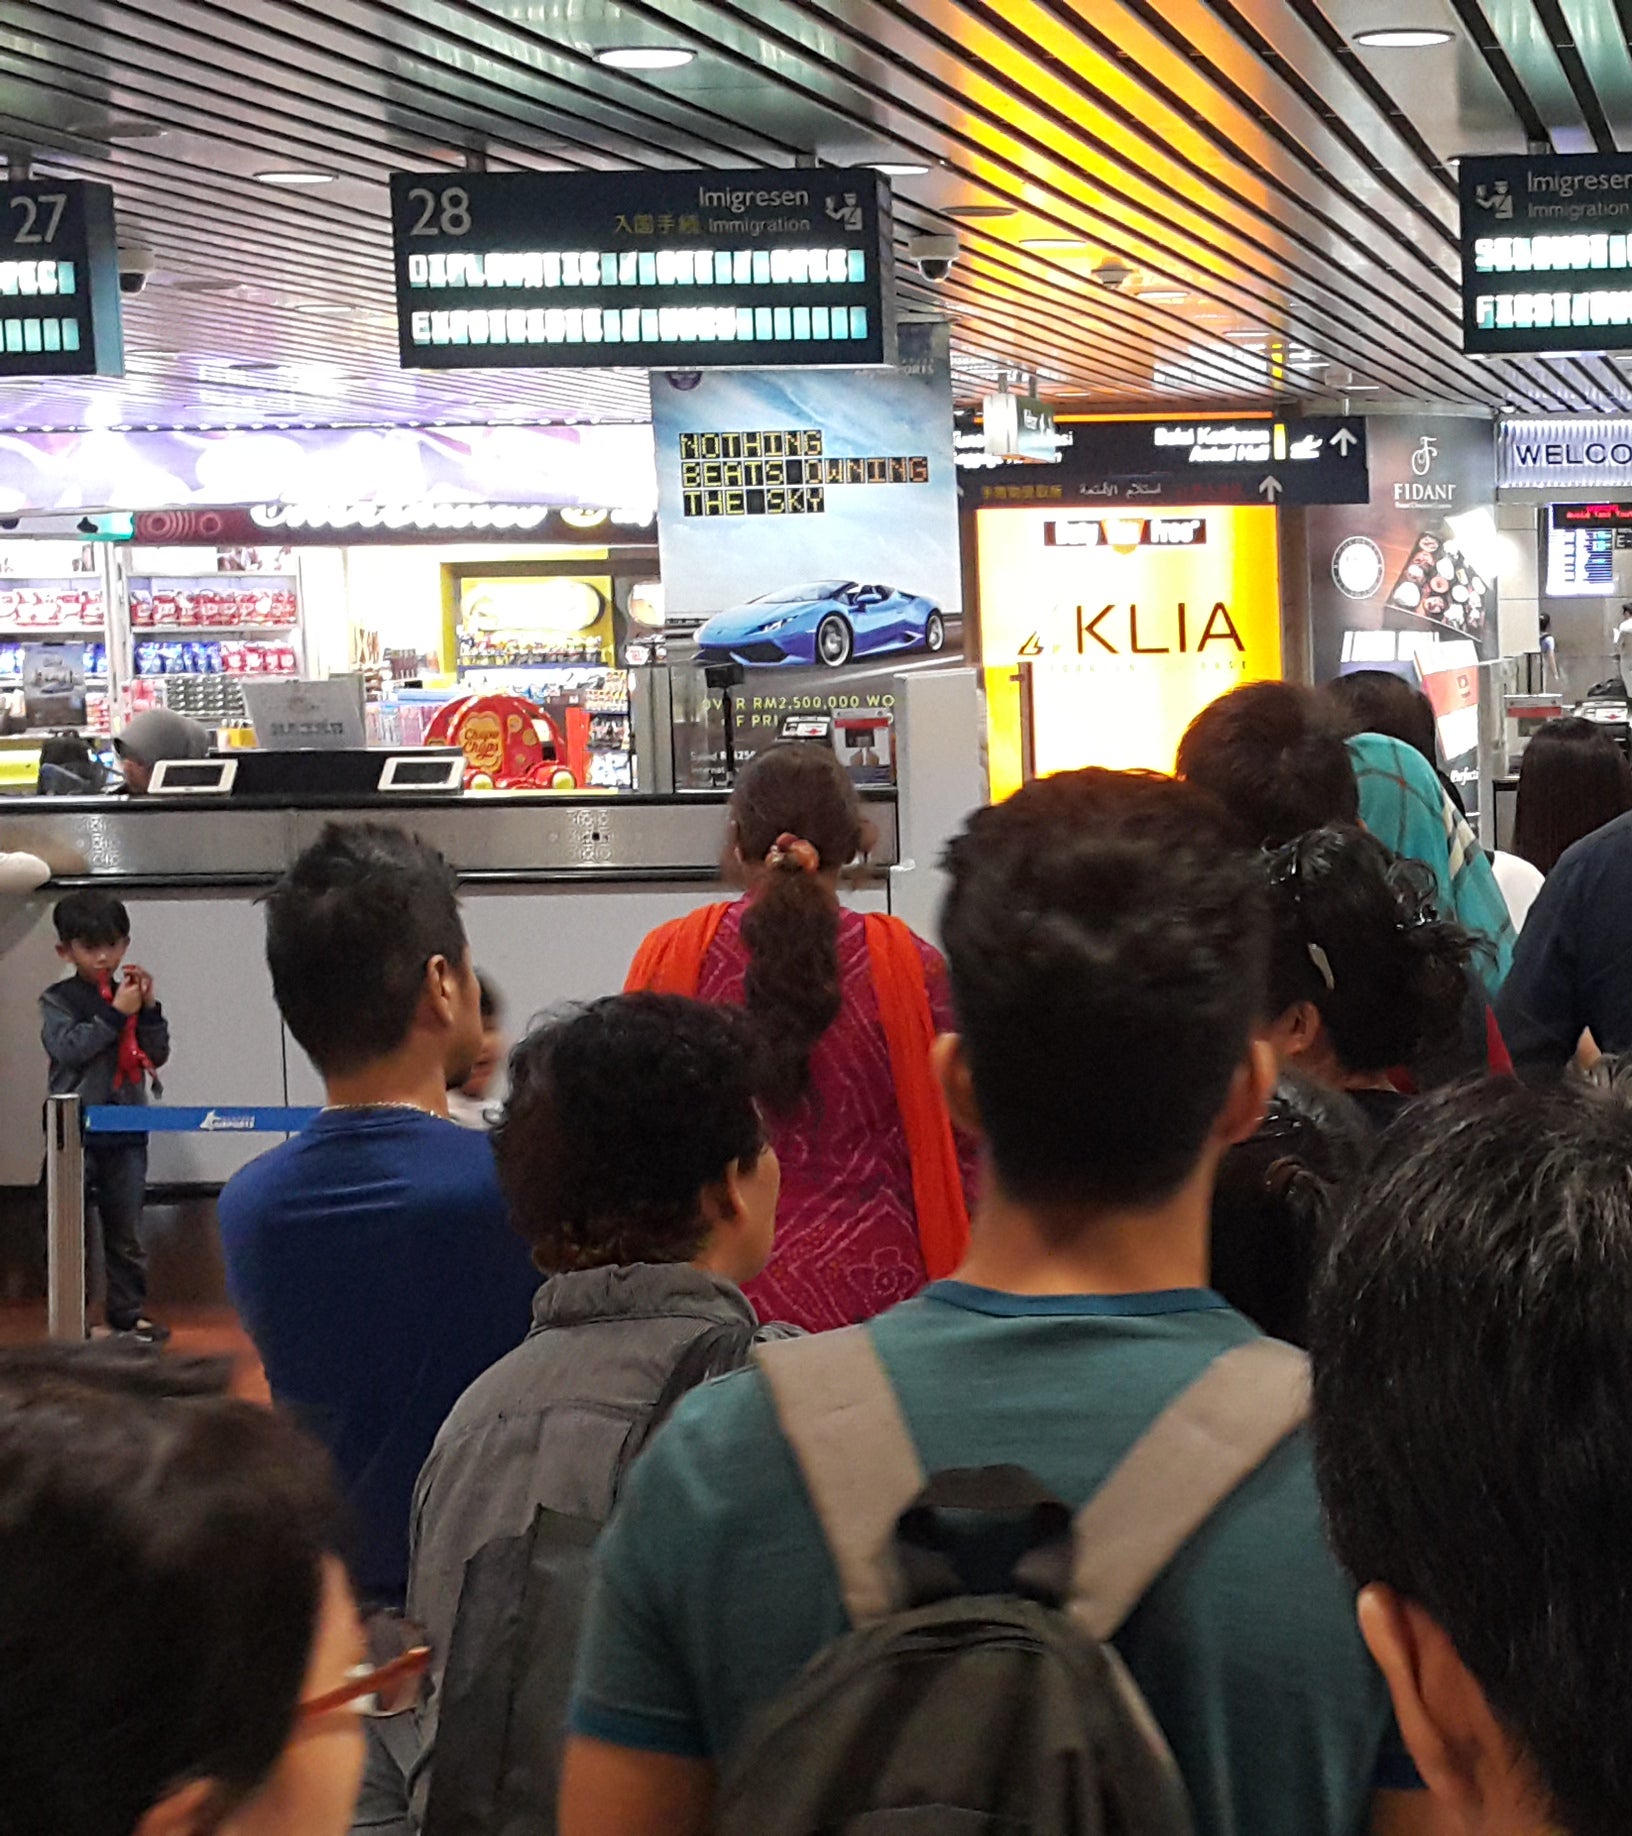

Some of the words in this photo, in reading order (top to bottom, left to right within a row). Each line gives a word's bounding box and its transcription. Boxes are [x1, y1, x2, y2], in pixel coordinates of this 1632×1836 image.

[408, 186, 472, 237] 28
[699, 186, 810, 213] Imigresen
[1528, 201, 1630, 221] Immigration
[10, 193, 67, 243] 27
[709, 216, 811, 237] Immigration
[681, 430, 822, 459] NOTHING
[682, 461, 784, 488] BEATS
[805, 457, 929, 484] OWNING
[684, 489, 745, 516] THE
[767, 487, 824, 514] SKY
[1076, 601, 1246, 654] KLIA
[702, 697, 746, 711] OVR
[867, 694, 896, 708] WO
[752, 714, 778, 727] PRI
